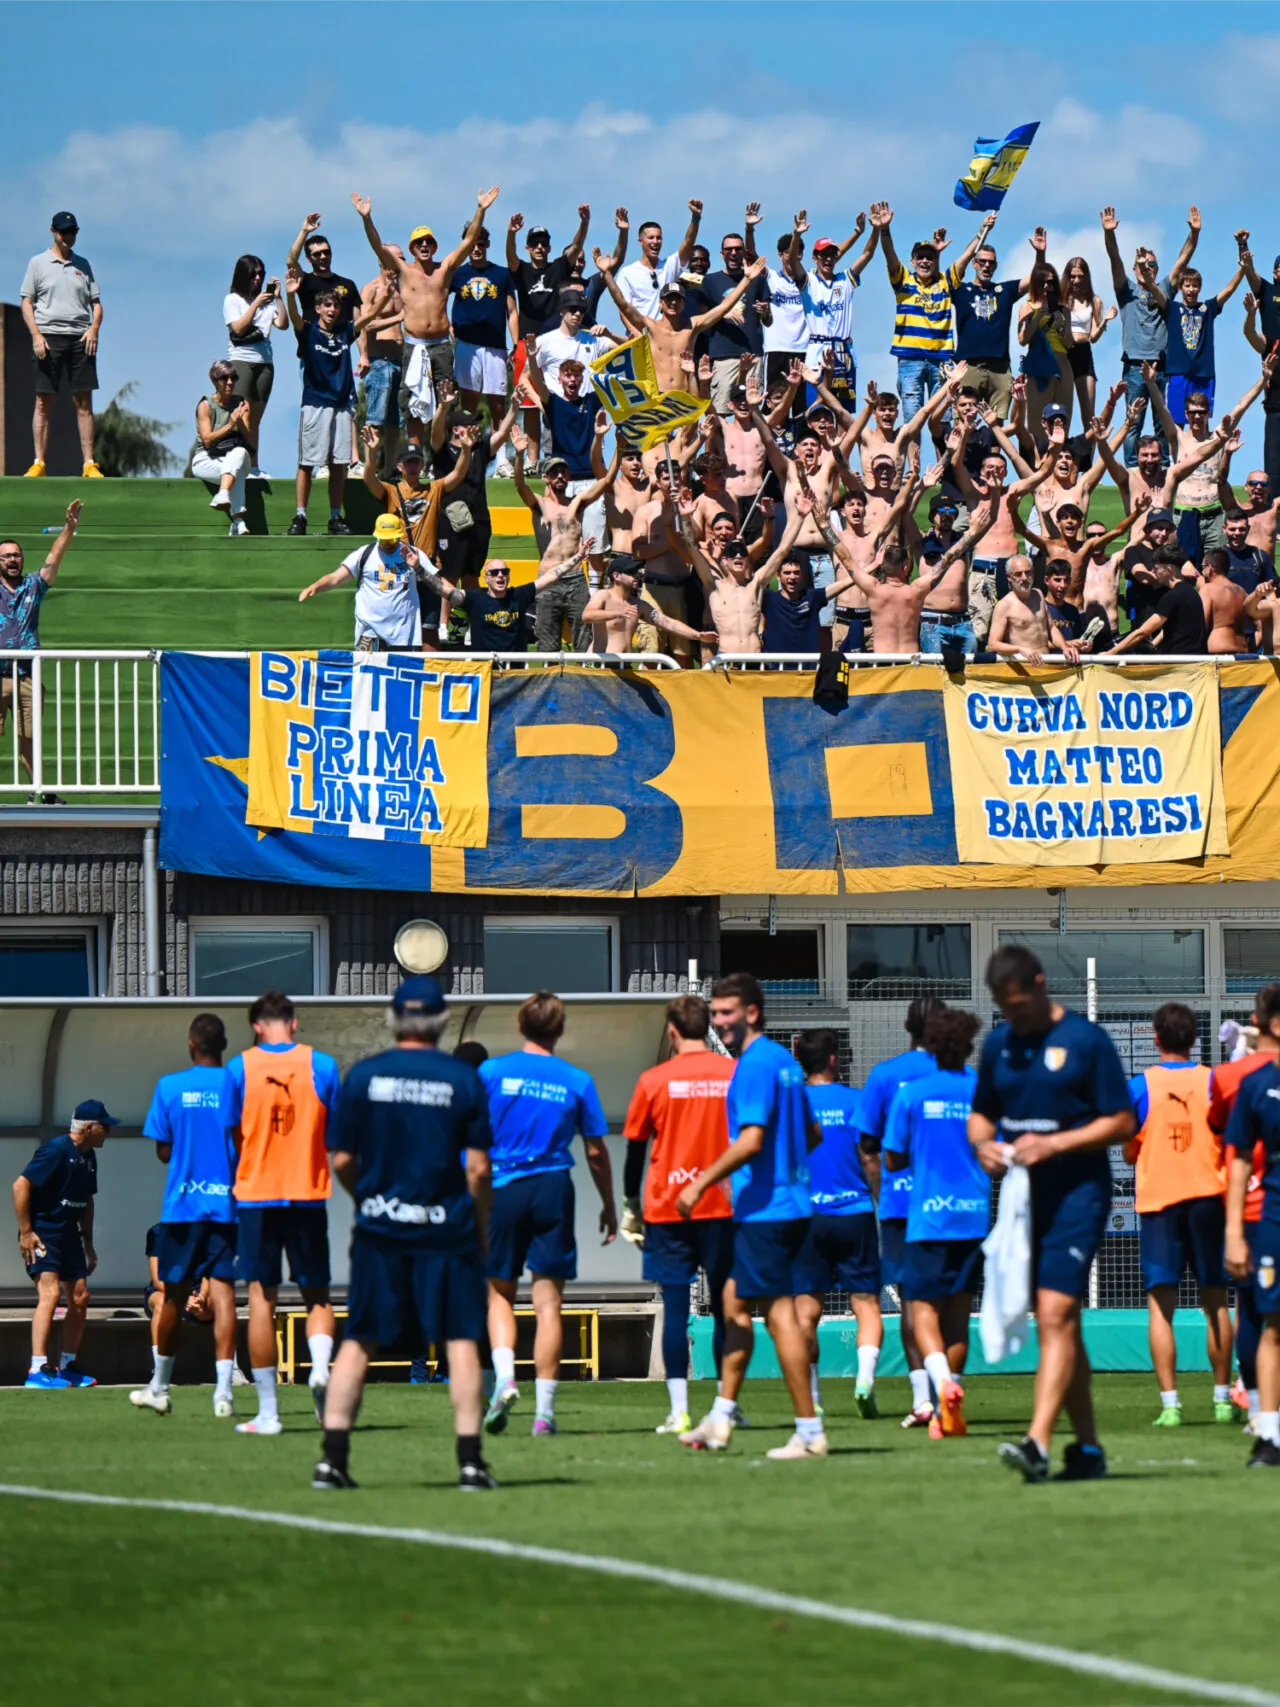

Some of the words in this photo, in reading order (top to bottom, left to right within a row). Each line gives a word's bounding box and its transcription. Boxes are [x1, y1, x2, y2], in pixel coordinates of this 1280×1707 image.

[260, 651, 482, 723] BIETTO
[966, 691, 1087, 733] CURVA
[1097, 689, 1193, 731] NORD
[287, 720, 446, 785] PRIMA
[1004, 744, 1163, 786] MATTEO
[288, 771, 443, 832] LINEA
[983, 791, 1203, 841] BAGNARESI
